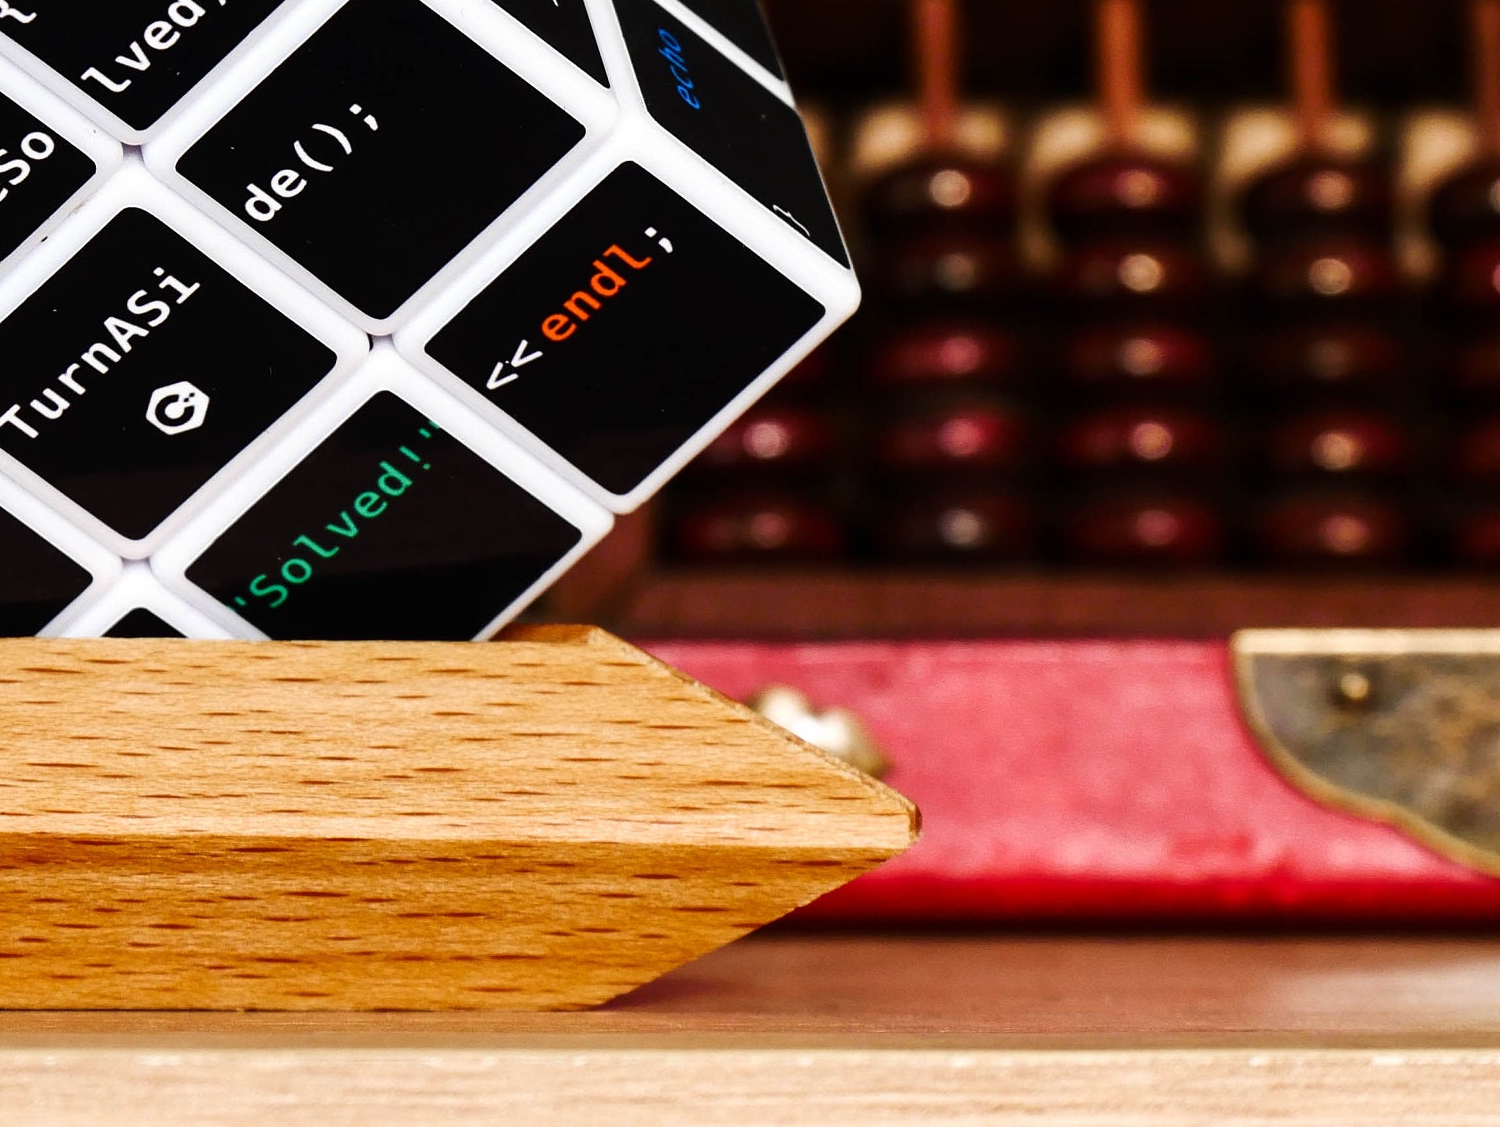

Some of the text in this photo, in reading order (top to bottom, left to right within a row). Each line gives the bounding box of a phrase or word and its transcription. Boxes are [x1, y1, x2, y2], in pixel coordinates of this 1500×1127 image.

[657, 28, 701, 110] echo
[244, 103, 379, 222] de();
[540, 226, 674, 343] endl;
